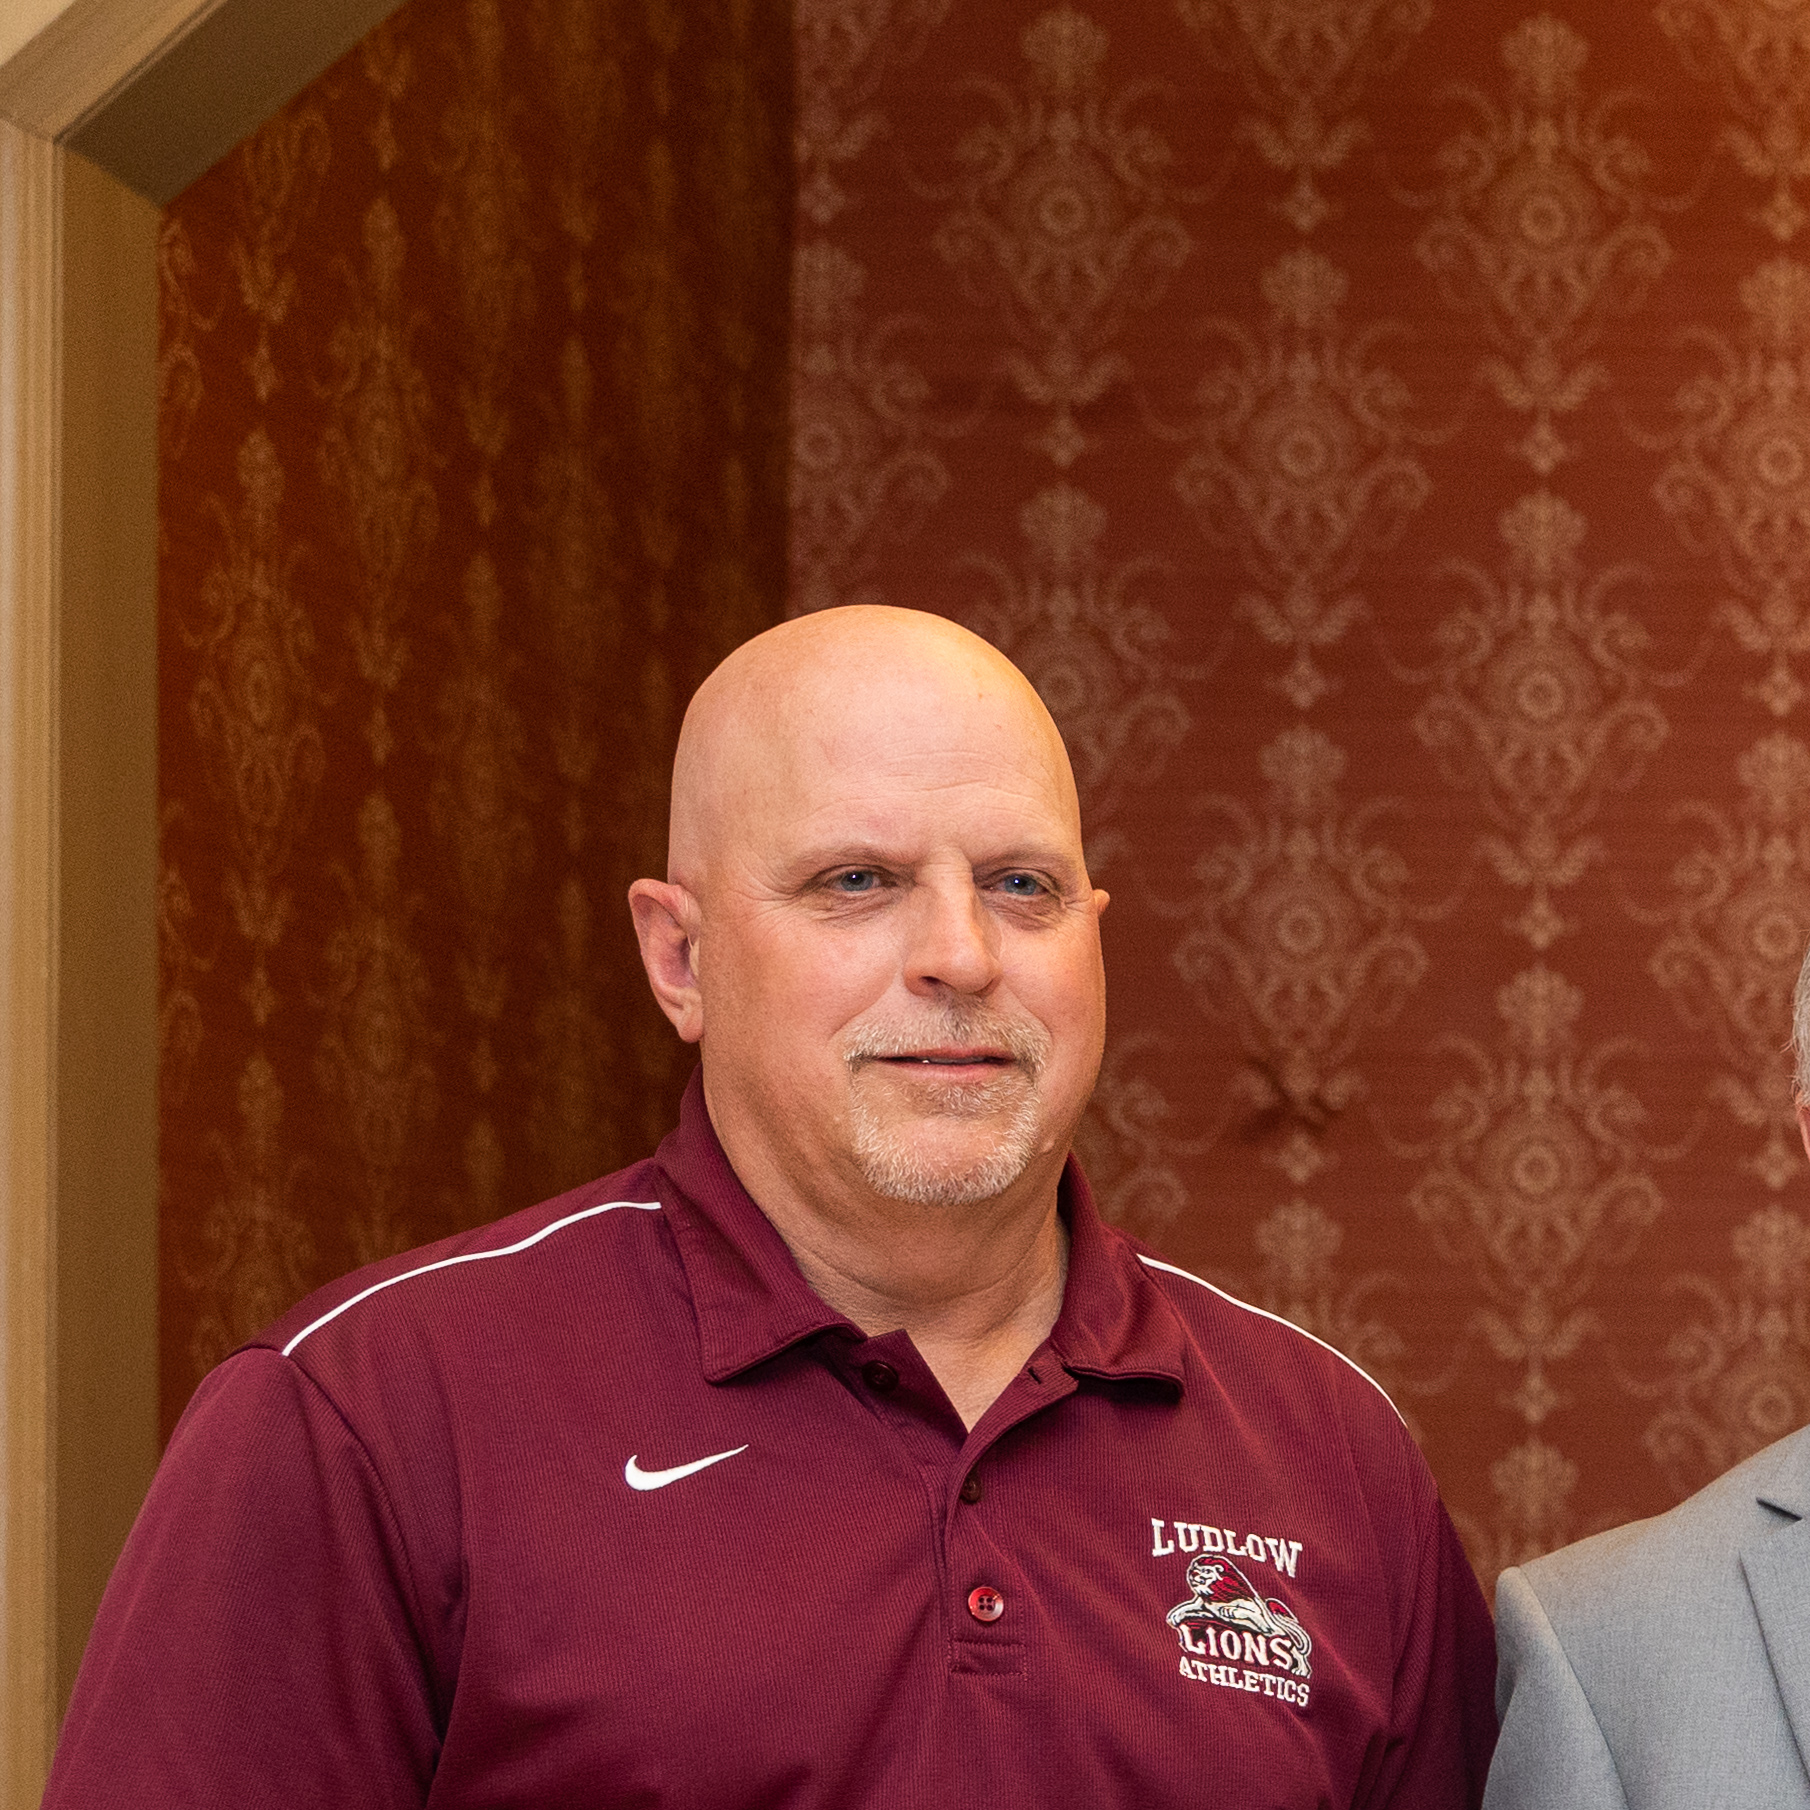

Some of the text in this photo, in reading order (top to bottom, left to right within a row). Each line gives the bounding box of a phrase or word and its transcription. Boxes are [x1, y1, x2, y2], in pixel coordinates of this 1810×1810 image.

[1151, 1517, 1303, 1578] LUDLOW
[1179, 1623, 1293, 1672] LIONS
[1178, 1655, 1310, 1708] ATHLETICS
